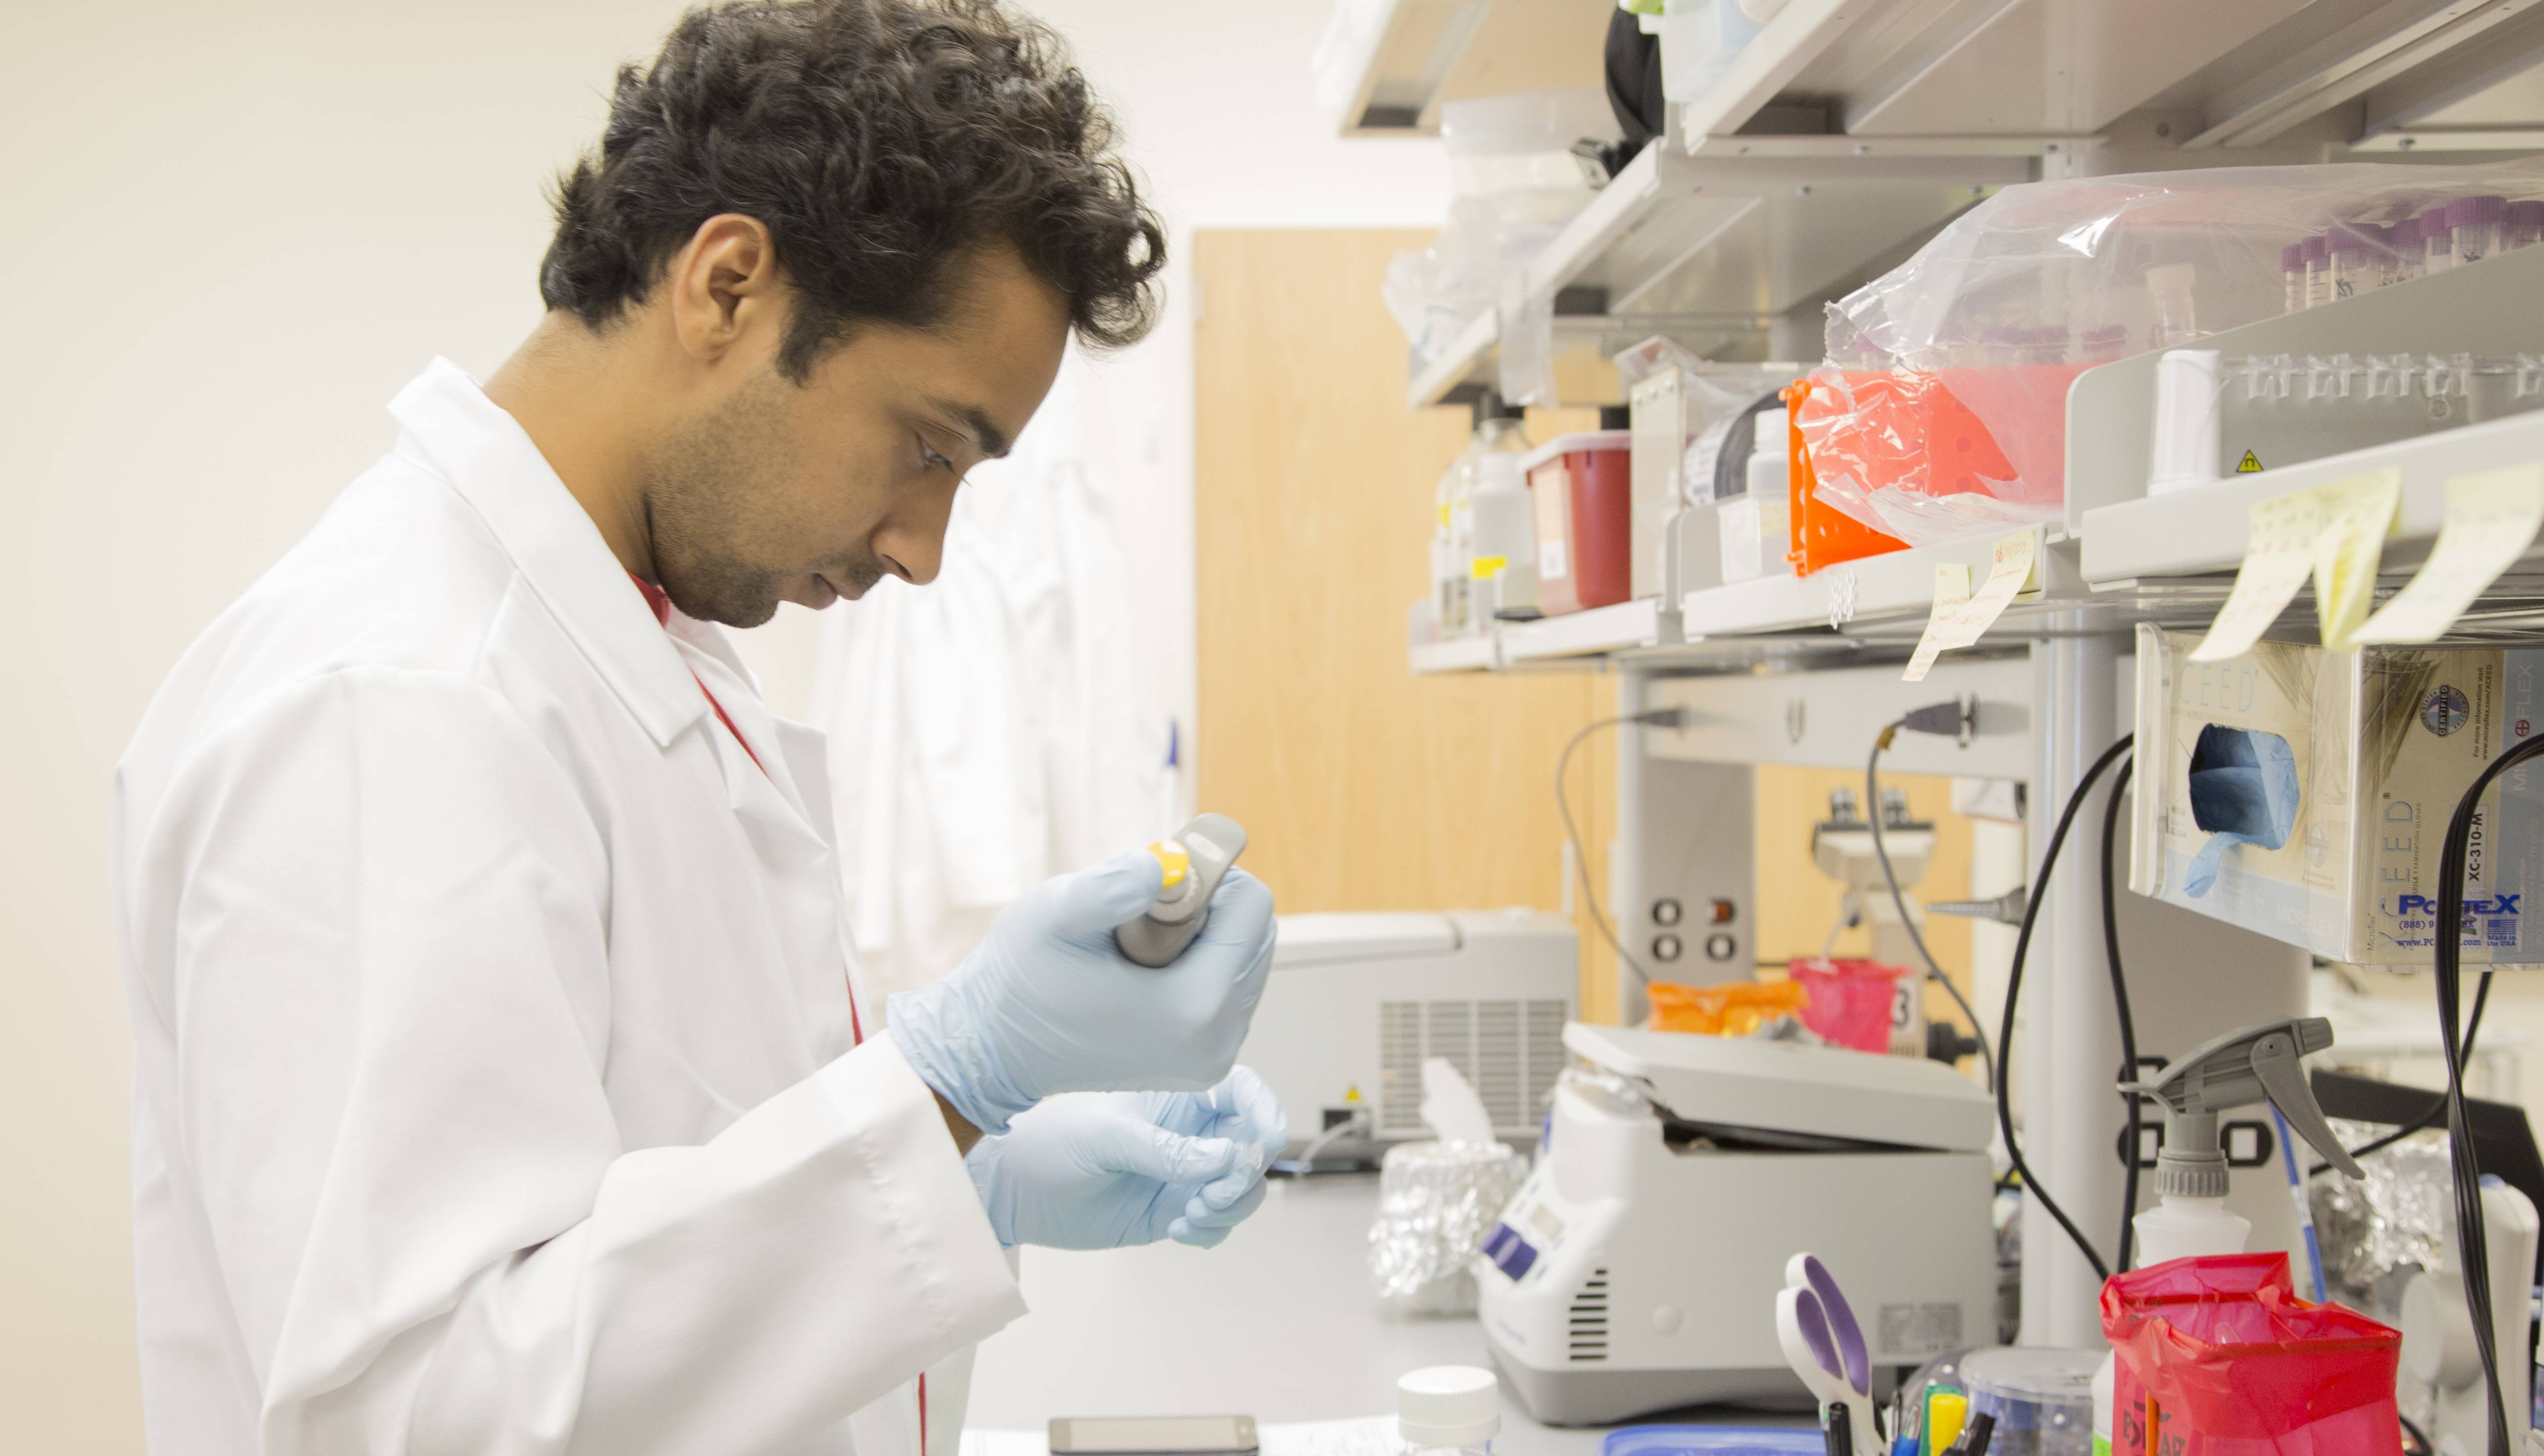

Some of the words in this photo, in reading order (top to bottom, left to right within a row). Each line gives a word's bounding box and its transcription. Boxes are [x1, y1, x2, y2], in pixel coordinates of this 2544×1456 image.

[2180, 662, 2254, 711] CEED
[2439, 685, 2448, 735] CERTIFIED
[2482, 664, 2493, 760] www.microflex.com/XCEED
[2469, 813, 2483, 882] XC-310-M
[2399, 894, 2520, 915] POTEX
[2399, 920, 2425, 930] (888)
